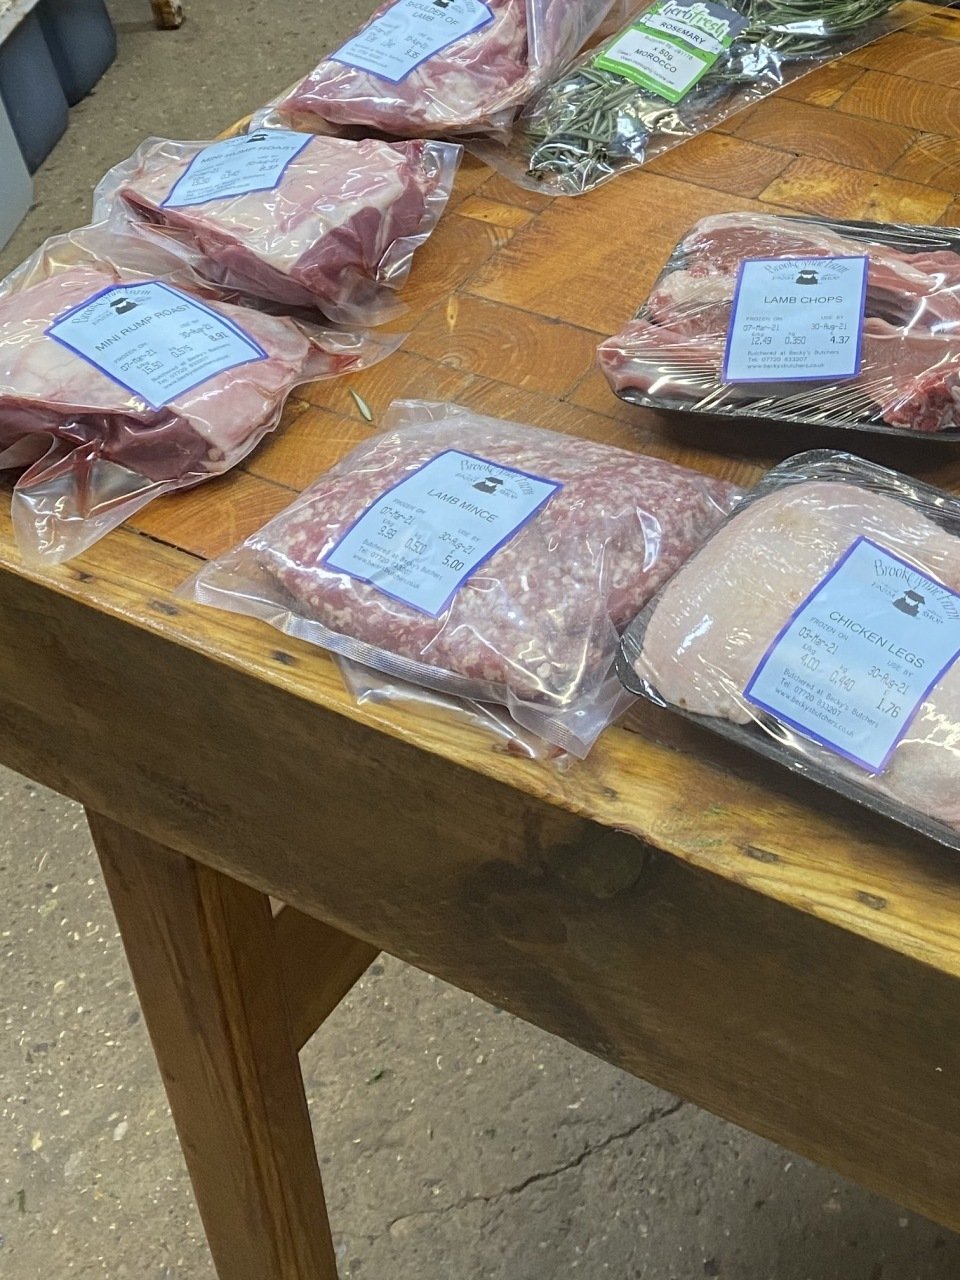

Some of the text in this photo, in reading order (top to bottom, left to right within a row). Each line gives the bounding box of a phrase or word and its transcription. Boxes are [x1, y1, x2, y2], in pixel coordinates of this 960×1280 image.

[405, 0, 447, 18] SHOULDER
[660, 21, 706, 45] ROSEMARY
[634, 48, 677, 73] MOROCCO
[764, 295, 843, 304] LAMB CHOPS
[95, 303, 192, 352] MINI RUMP ROAST
[829, 335, 850, 344] 4.37
[427, 488, 499, 523] LAMB MINCE
[441, 554, 465, 571] 5.00
[829, 610, 925, 669] CHICKEN LEGS
[876, 697, 902, 719] 1.76
